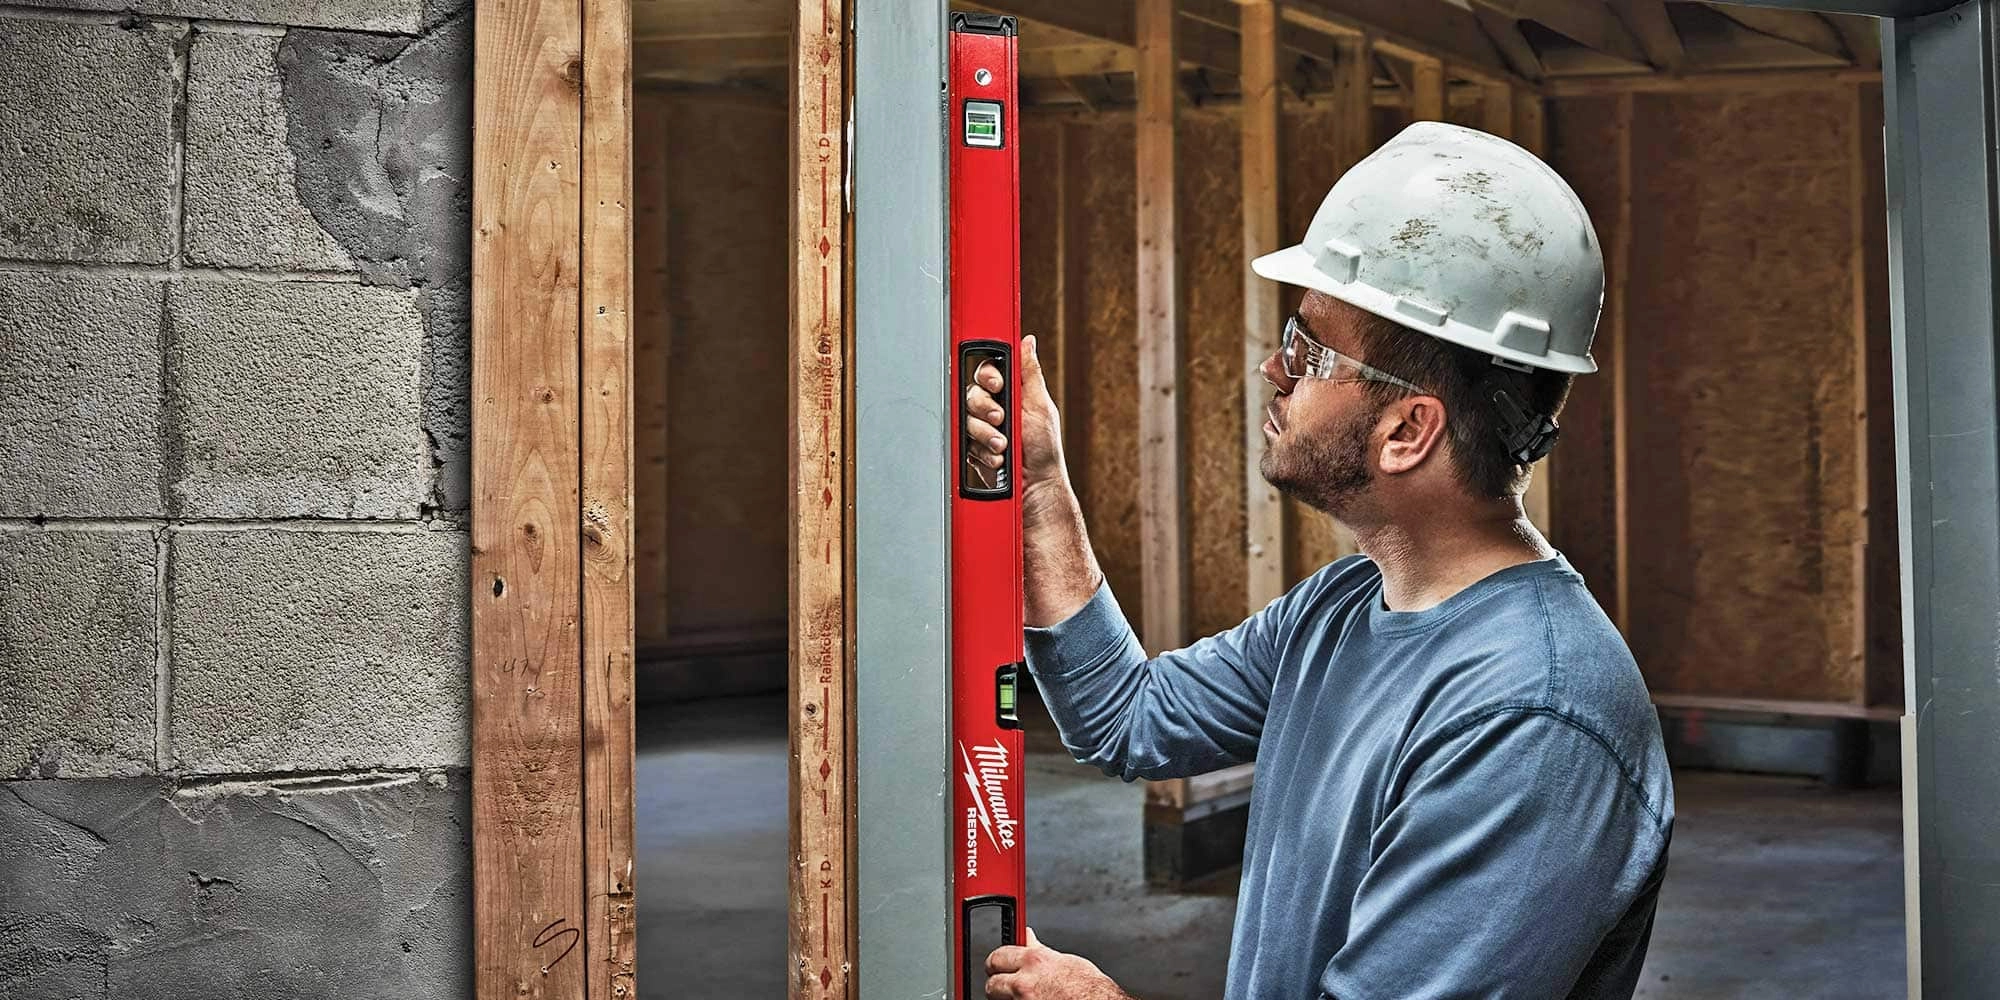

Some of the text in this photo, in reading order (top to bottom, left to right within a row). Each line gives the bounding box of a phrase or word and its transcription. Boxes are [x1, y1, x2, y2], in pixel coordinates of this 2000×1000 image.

[820, 620, 832, 684] Rainkote
[971, 737, 1018, 850] Milwaukee
[967, 807, 977, 878] REDSTICK
